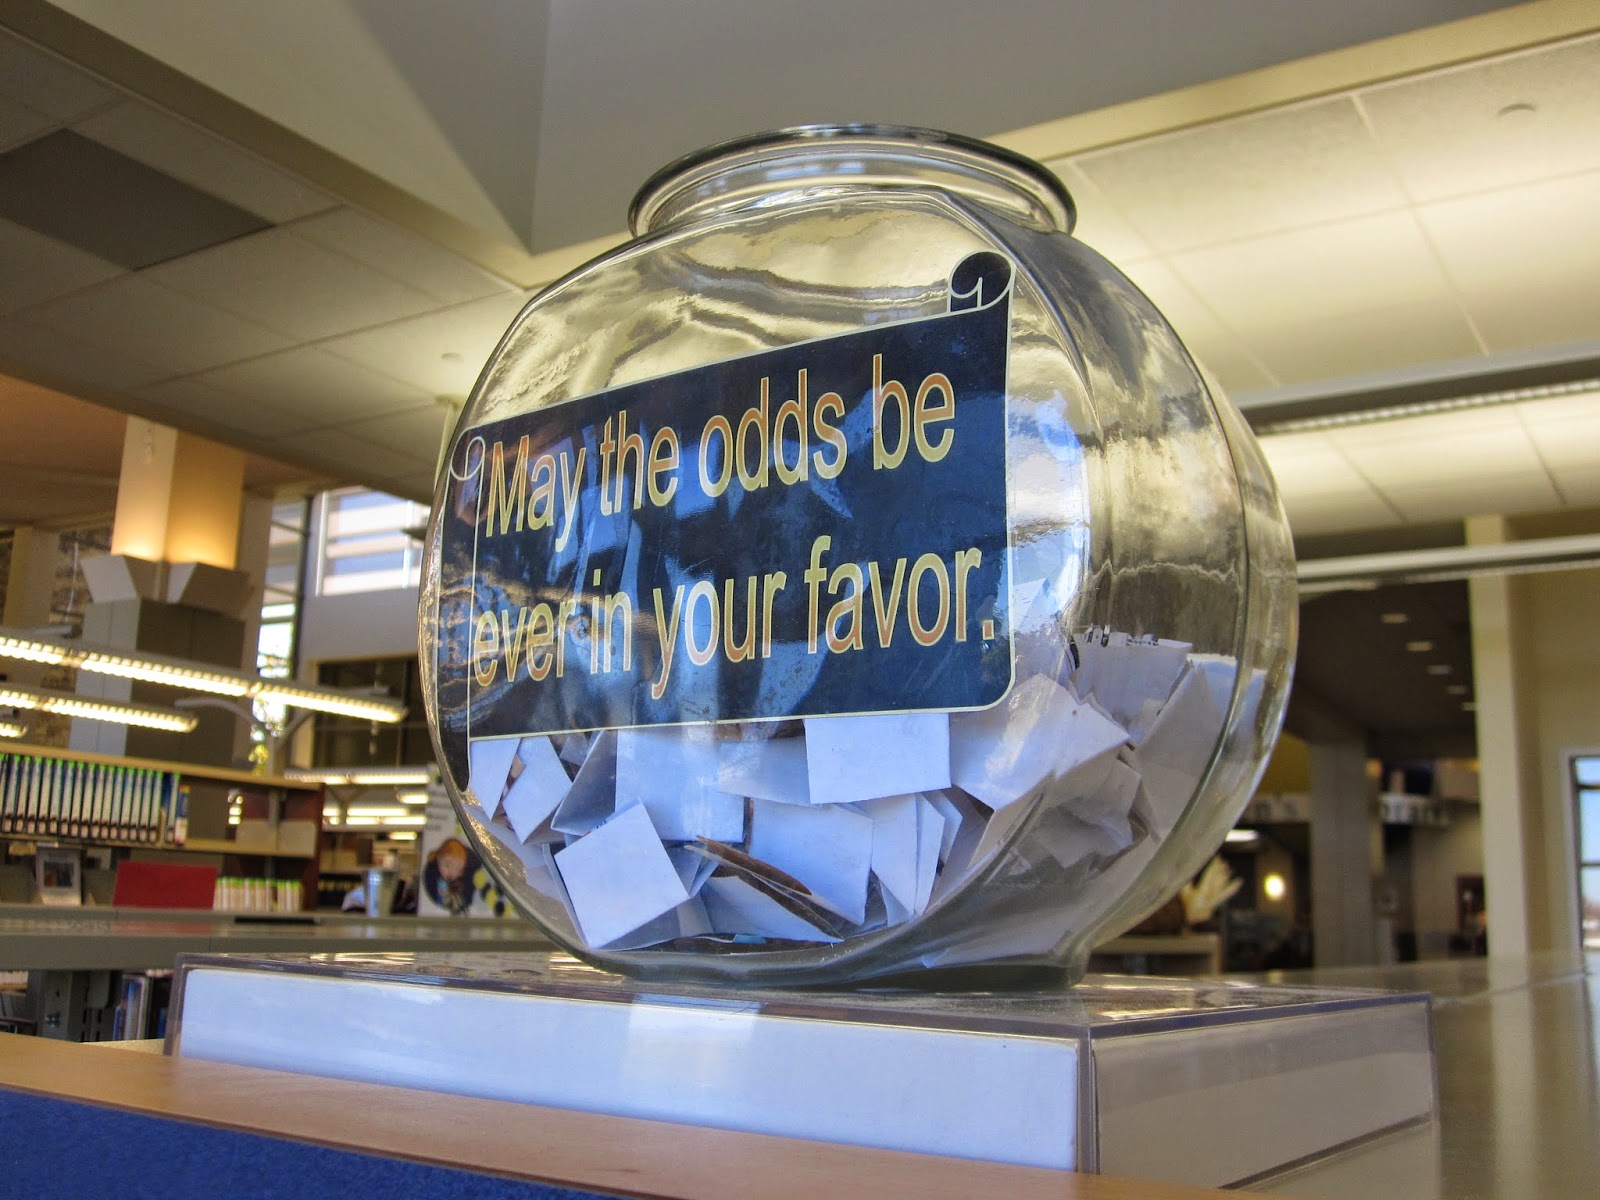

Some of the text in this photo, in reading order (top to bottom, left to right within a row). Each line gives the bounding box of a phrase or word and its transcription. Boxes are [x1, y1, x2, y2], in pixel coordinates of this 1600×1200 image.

[485, 353, 955, 553] May the odds be
[473, 535, 995, 700] ever in your favor.
